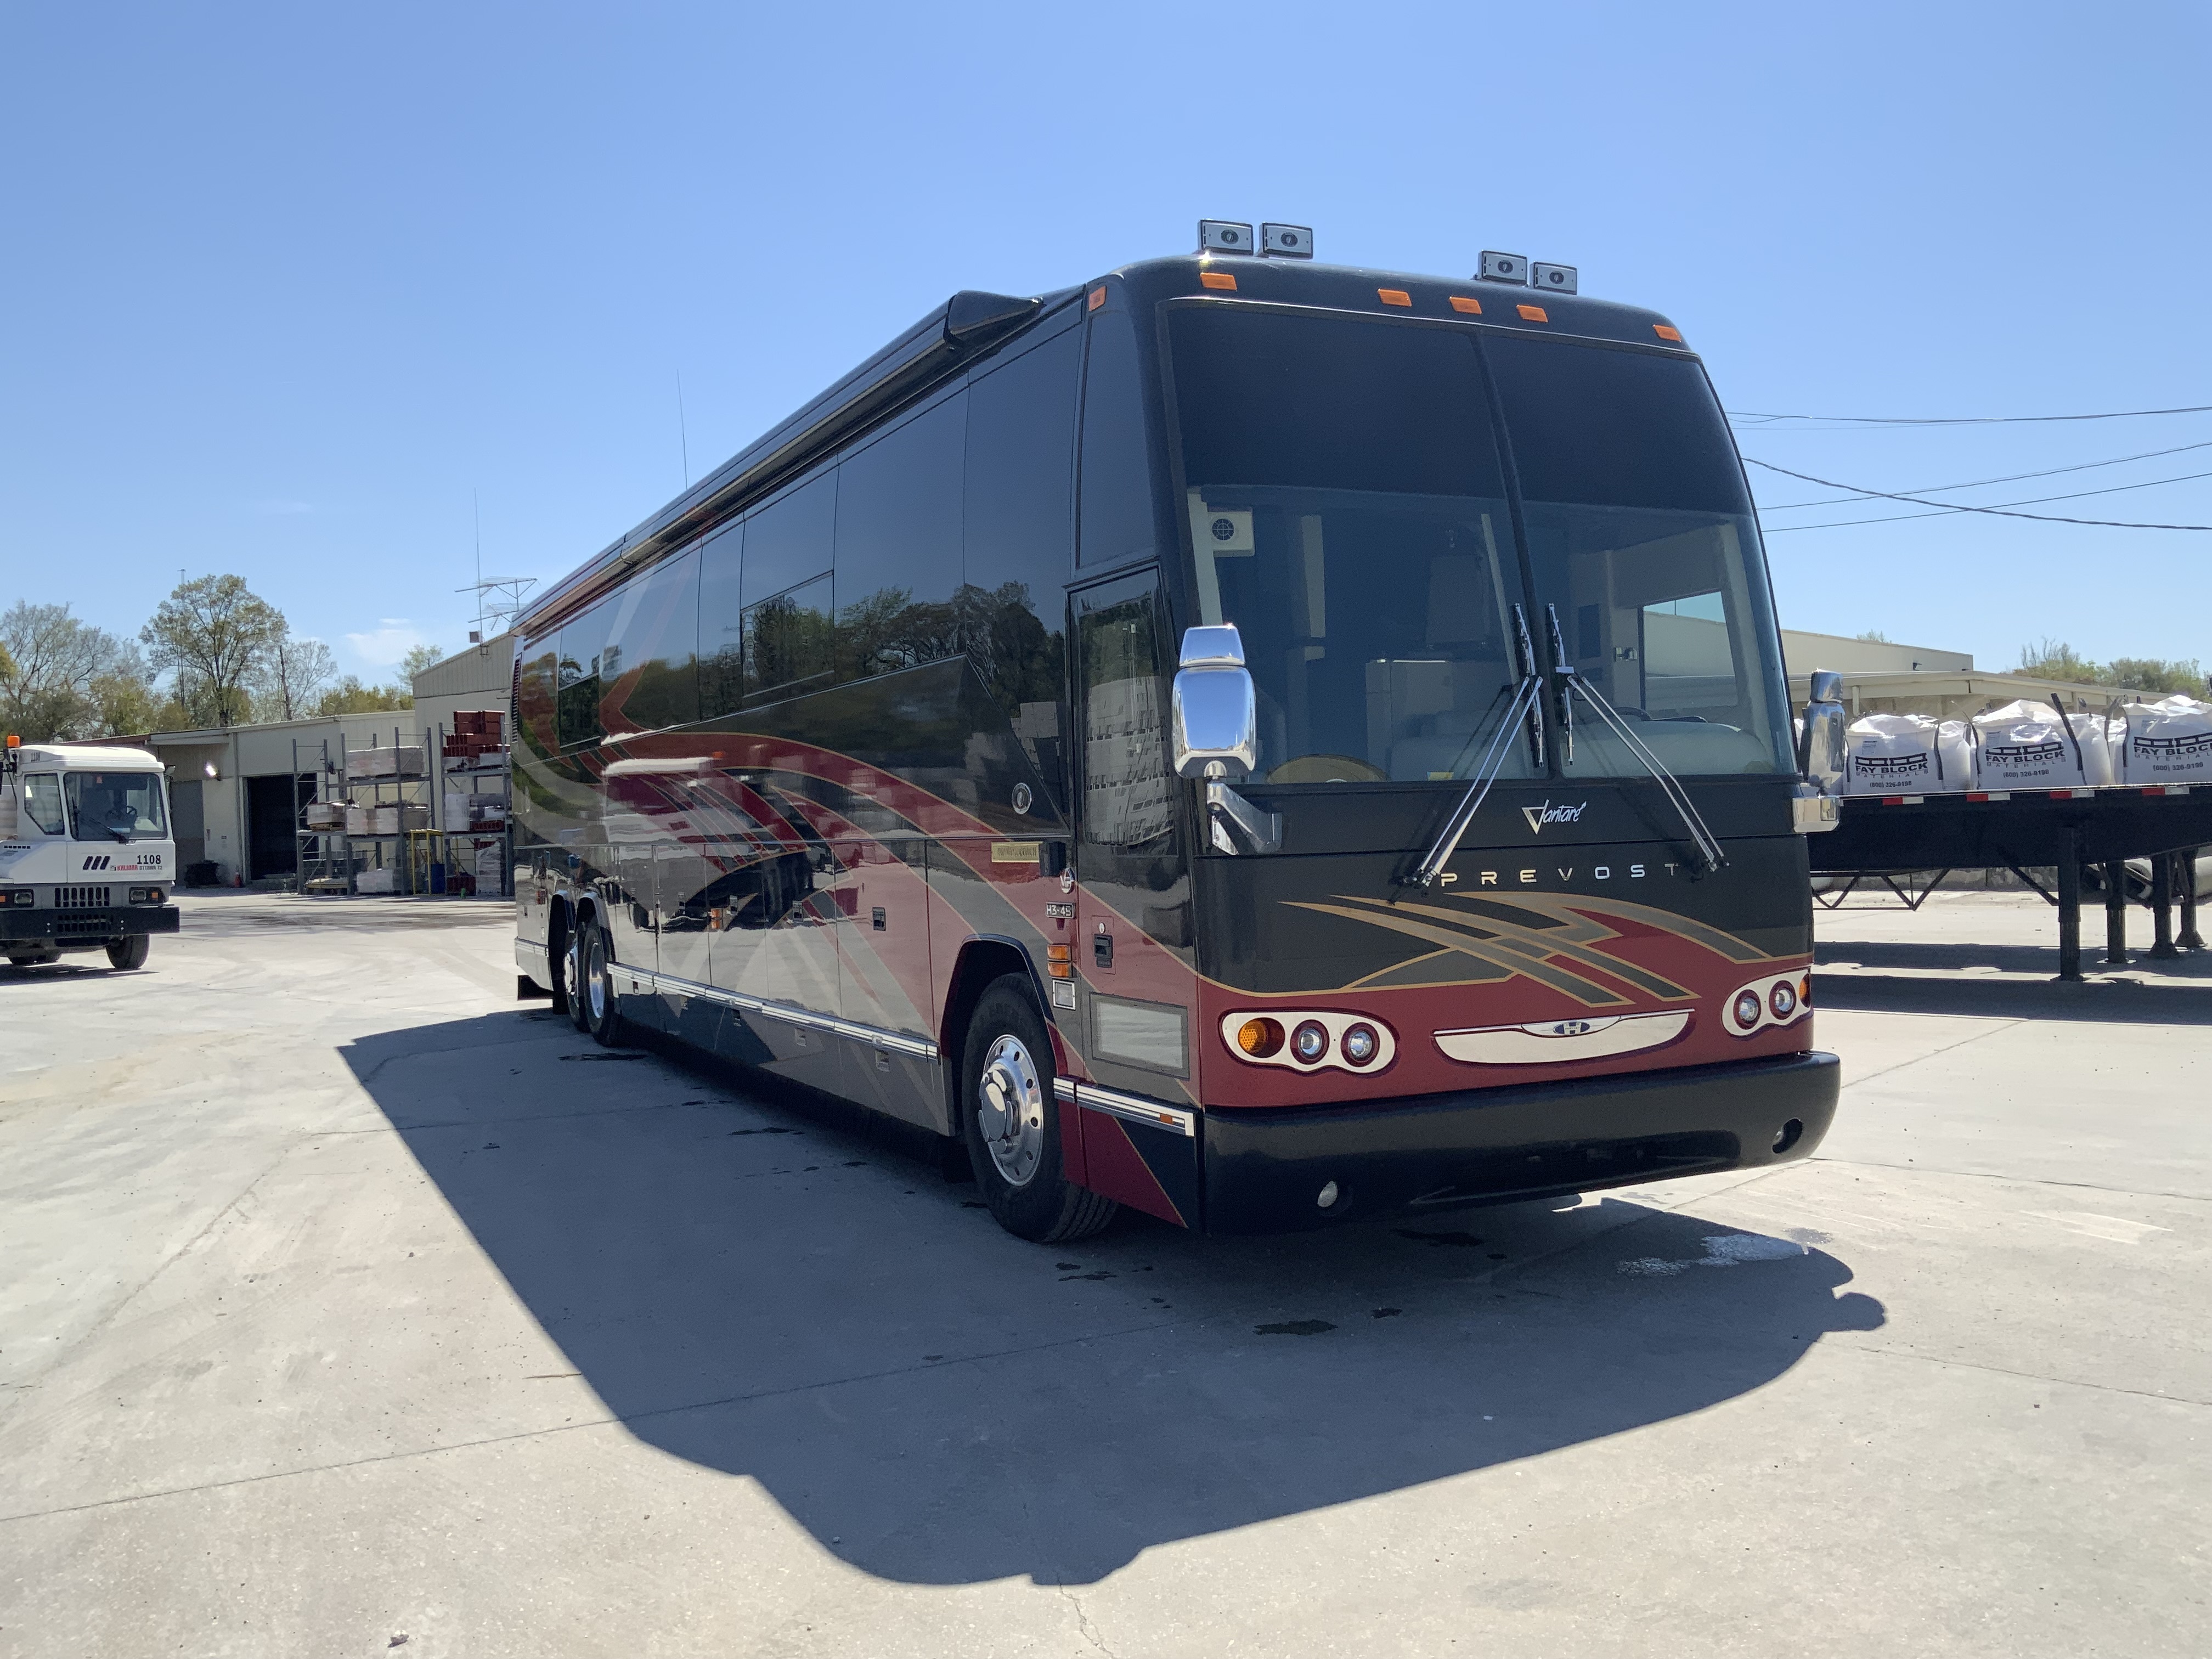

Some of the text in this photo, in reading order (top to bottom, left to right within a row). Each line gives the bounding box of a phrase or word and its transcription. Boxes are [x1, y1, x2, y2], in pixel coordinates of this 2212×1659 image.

[2134, 743, 2212, 755] FAY BLOC
[2015, 750, 2065, 763] BLOCK
[1855, 762, 1928, 774] FAY BLOCK
[137, 855, 161, 864] 1108
[1440, 863, 1678, 887] PREVOST
